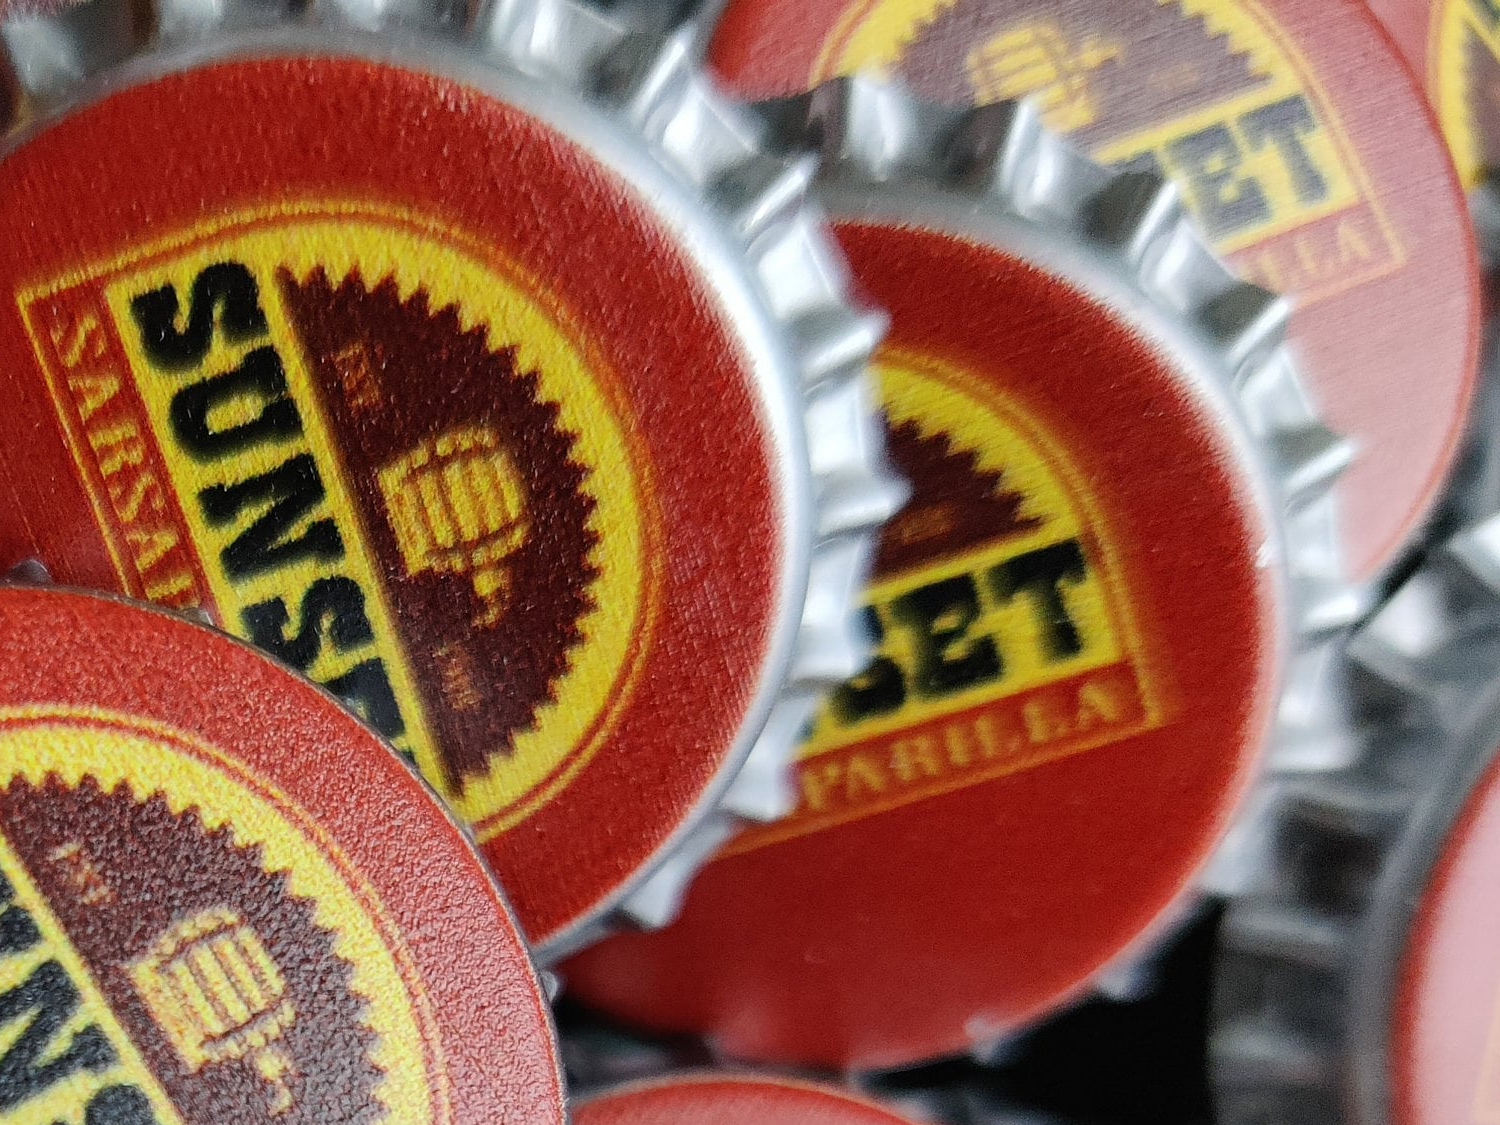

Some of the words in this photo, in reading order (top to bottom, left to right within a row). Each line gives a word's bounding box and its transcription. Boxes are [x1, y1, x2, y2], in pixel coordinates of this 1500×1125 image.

[130, 261, 420, 768] SUNS
[800, 537, 1087, 744] SET
[801, 681, 1118, 811] PARILLA
